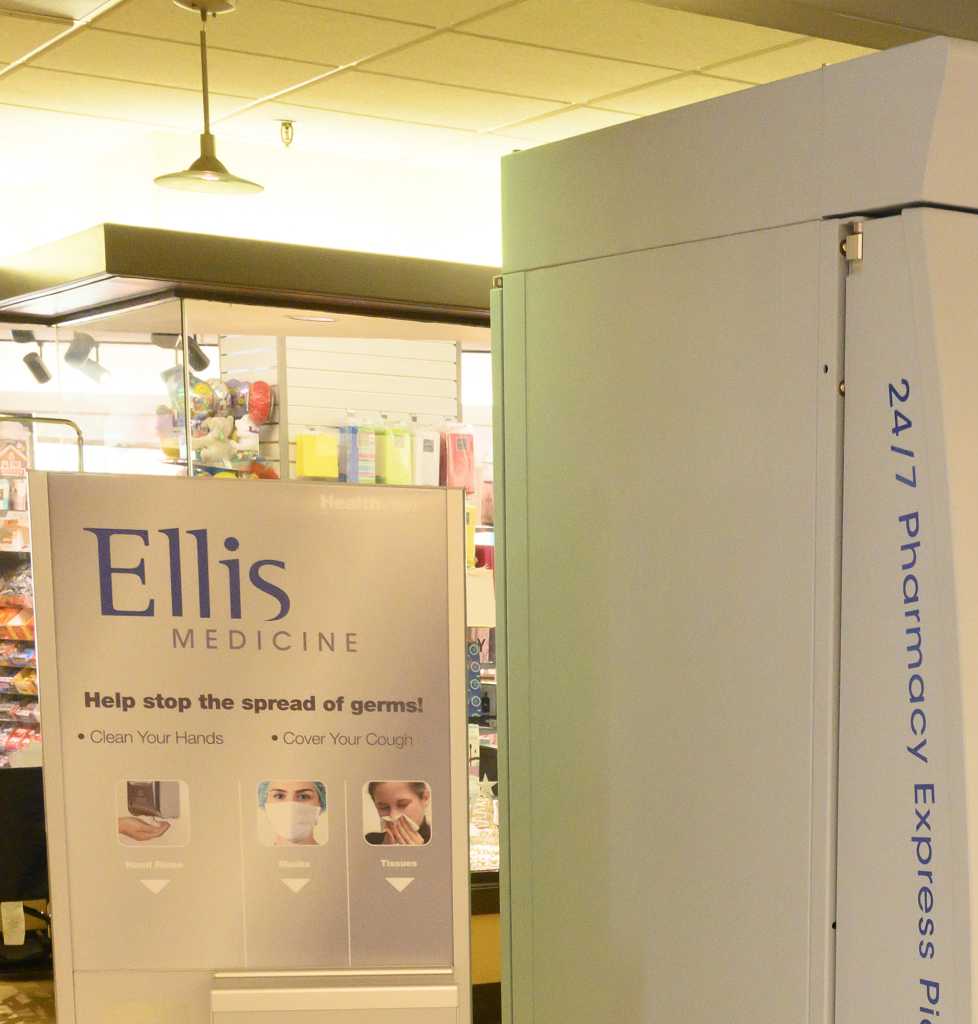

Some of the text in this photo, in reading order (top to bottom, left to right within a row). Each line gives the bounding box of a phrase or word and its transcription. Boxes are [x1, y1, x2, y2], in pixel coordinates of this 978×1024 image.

[888, 378, 917, 489] 24/7
[82, 527, 291, 622] Ellis
[172, 628, 359, 653] MEDICINE
[898, 511, 929, 766] Pharmacy
[84, 691, 423, 715] Help stop the spread of germs!
[89, 729, 224, 745] Clean Your Hands
[282, 731, 413, 749] Cover Your Cough
[380, 859, 418, 868] Tissues
[911, 783, 936, 959] Express
